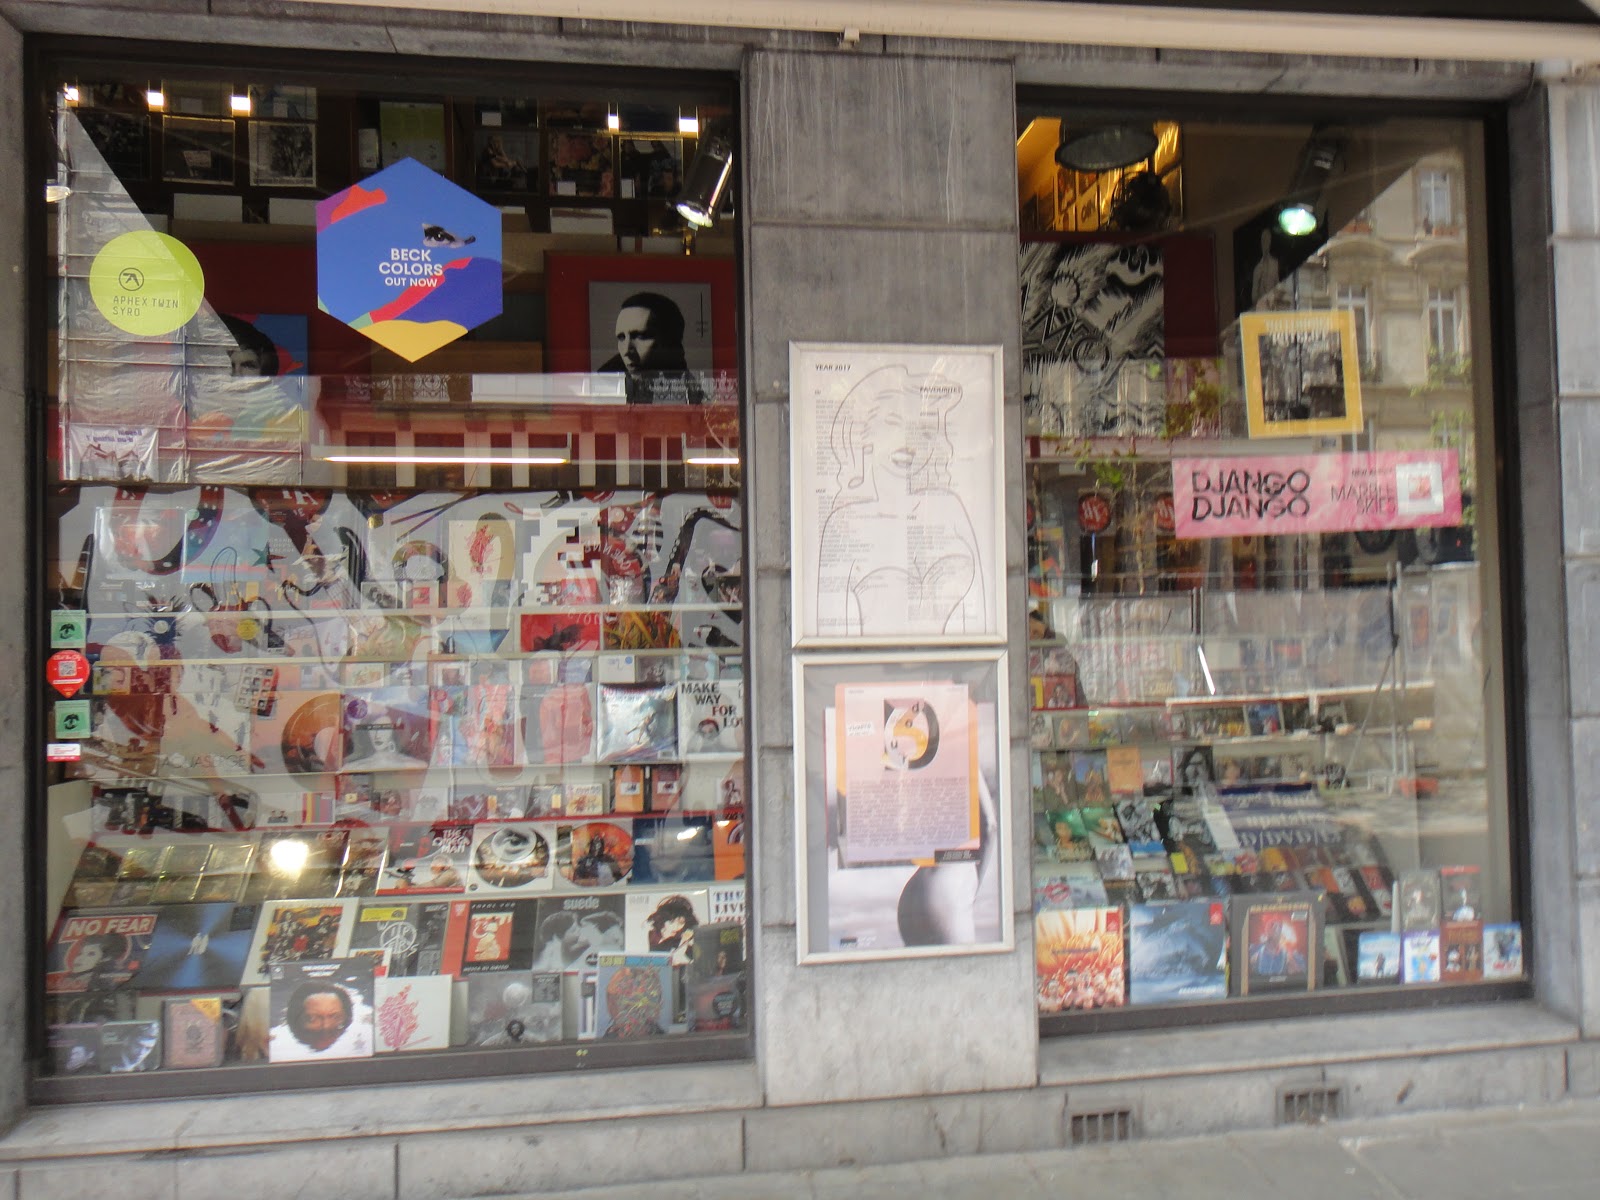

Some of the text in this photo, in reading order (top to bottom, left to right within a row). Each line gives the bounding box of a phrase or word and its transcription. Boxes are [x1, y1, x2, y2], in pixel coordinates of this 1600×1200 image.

[391, 248, 431, 261] BECK
[379, 262, 443, 276] COLORS
[385, 277, 438, 287] OUT NOW
[113, 296, 178, 309] APHEX TWIN
[112, 306, 140, 317] SYRO
[1192, 469, 1310, 495] DJANGO
[1191, 495, 1310, 521] DJANGO
[681, 682, 720, 694] MAKE
[695, 693, 721, 705] WAY
[712, 704, 737, 716] FOR
[723, 716, 743, 729] LO
[563, 896, 600, 911] suede
[66, 917, 151, 937] NO FEAR
